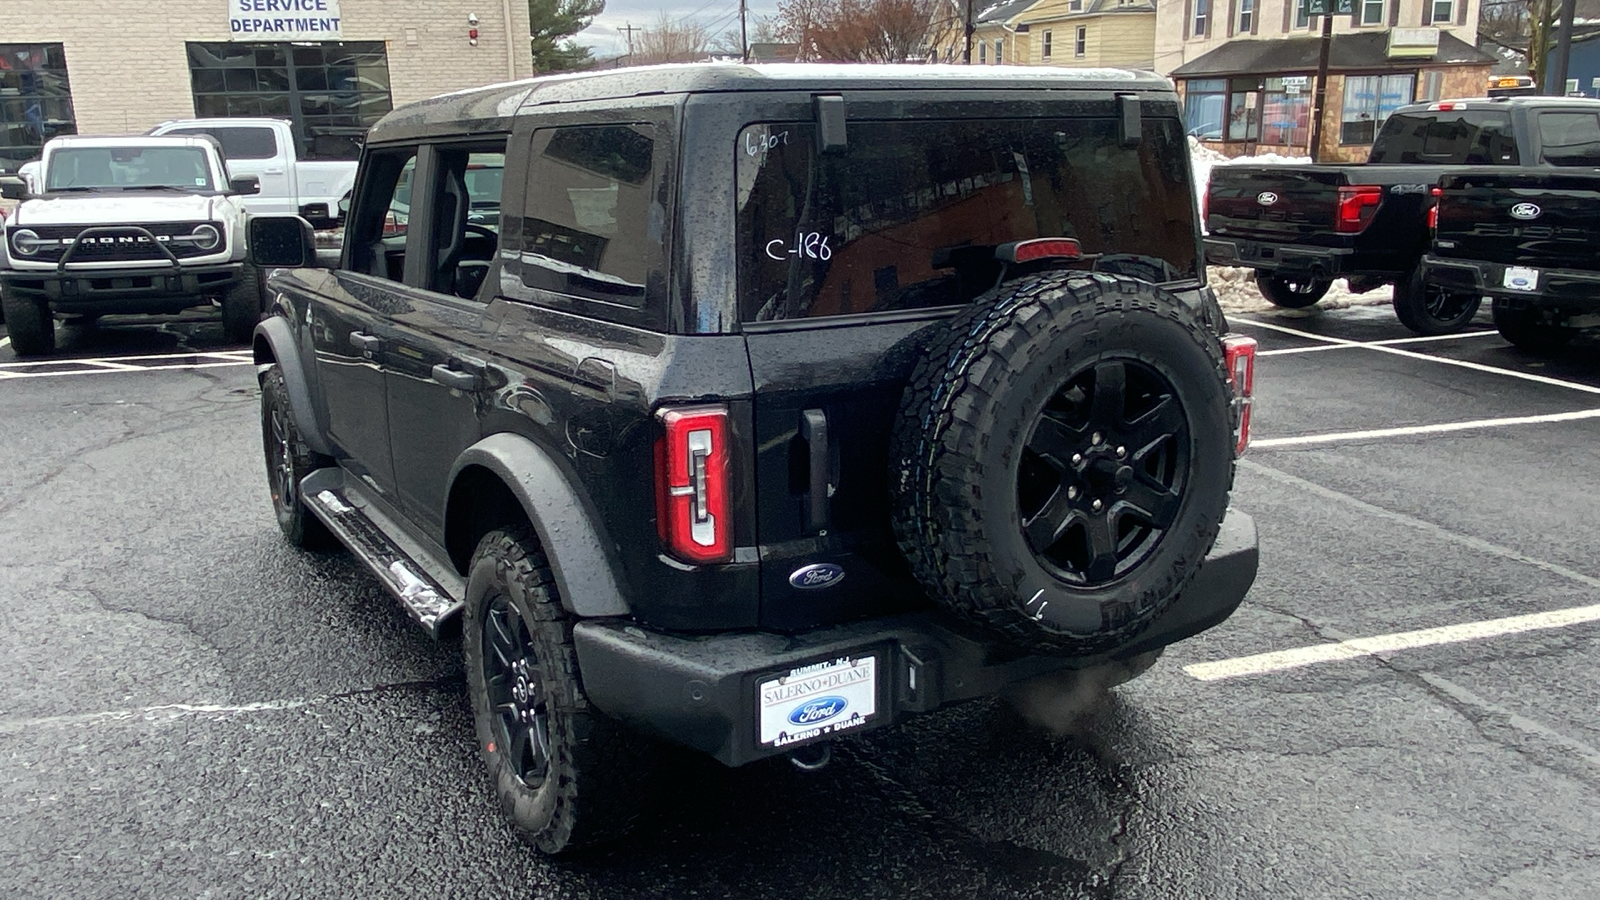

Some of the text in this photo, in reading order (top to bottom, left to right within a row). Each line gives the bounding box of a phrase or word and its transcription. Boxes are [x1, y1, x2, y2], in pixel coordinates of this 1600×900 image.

[240, 0, 327, 11] SERVICE
[231, 18, 340, 32] DEPARTMENT
[746, 131, 789, 156] 6307
[62, 235, 170, 245] BRONCO
[803, 568, 833, 585] Ford
[764, 666, 871, 704] SALERNO DUANE
[799, 700, 837, 722] Ford
[774, 716, 866, 747] SALERNO DUANE
